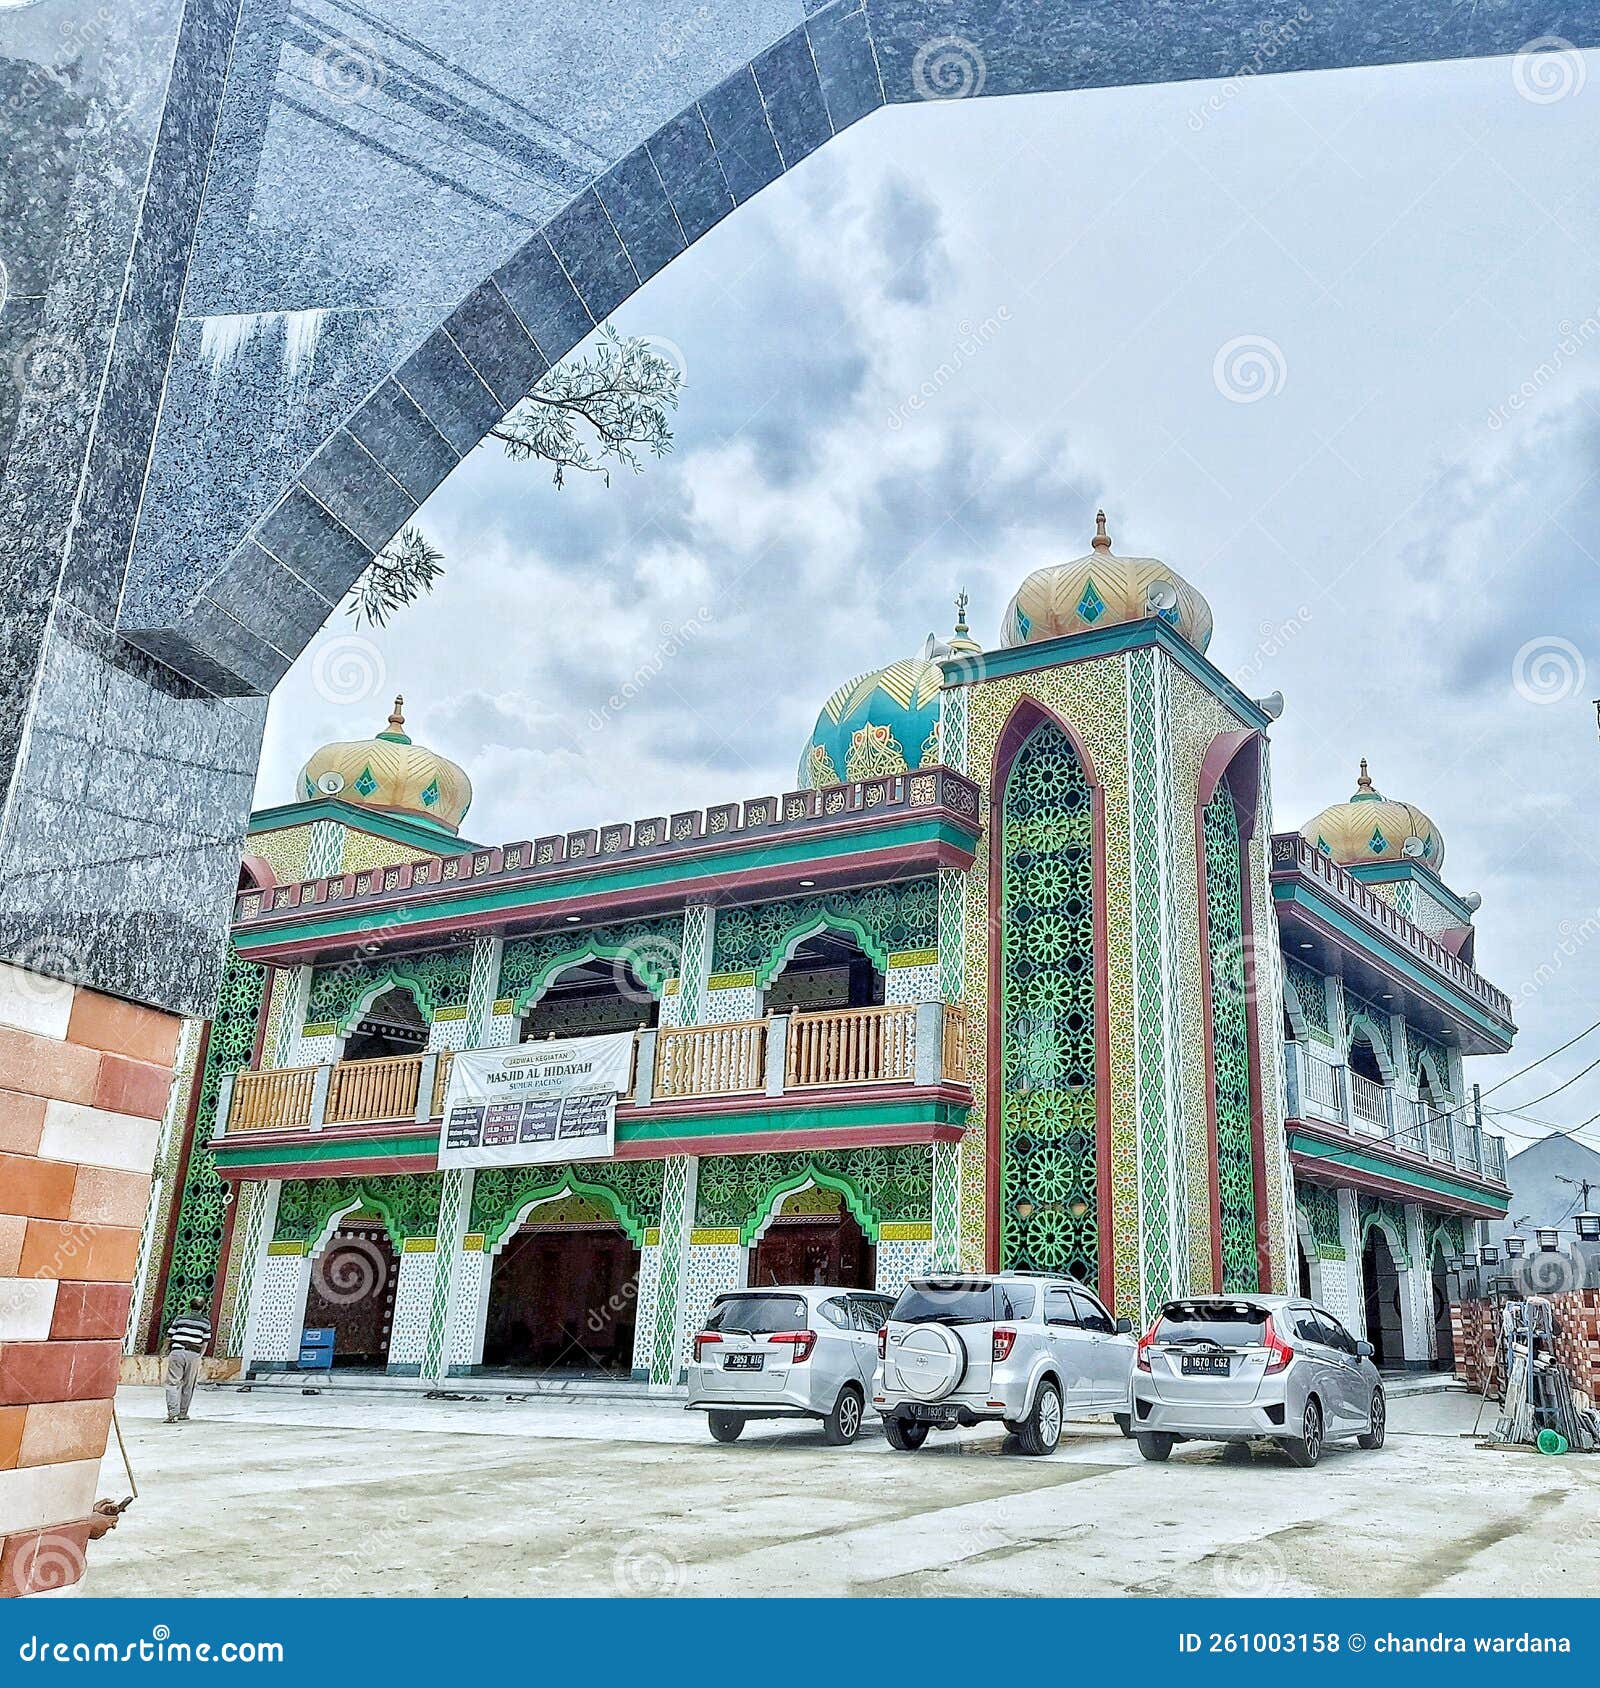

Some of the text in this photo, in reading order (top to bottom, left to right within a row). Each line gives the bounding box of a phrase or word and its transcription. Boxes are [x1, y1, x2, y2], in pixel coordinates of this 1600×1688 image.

[509, 1053, 569, 1066] JADWAL KEGIATAN
[487, 1062, 592, 1084] MASJID AL HIDAYAH
[1183, 1357, 1228, 1368] B 1670 CGZ
